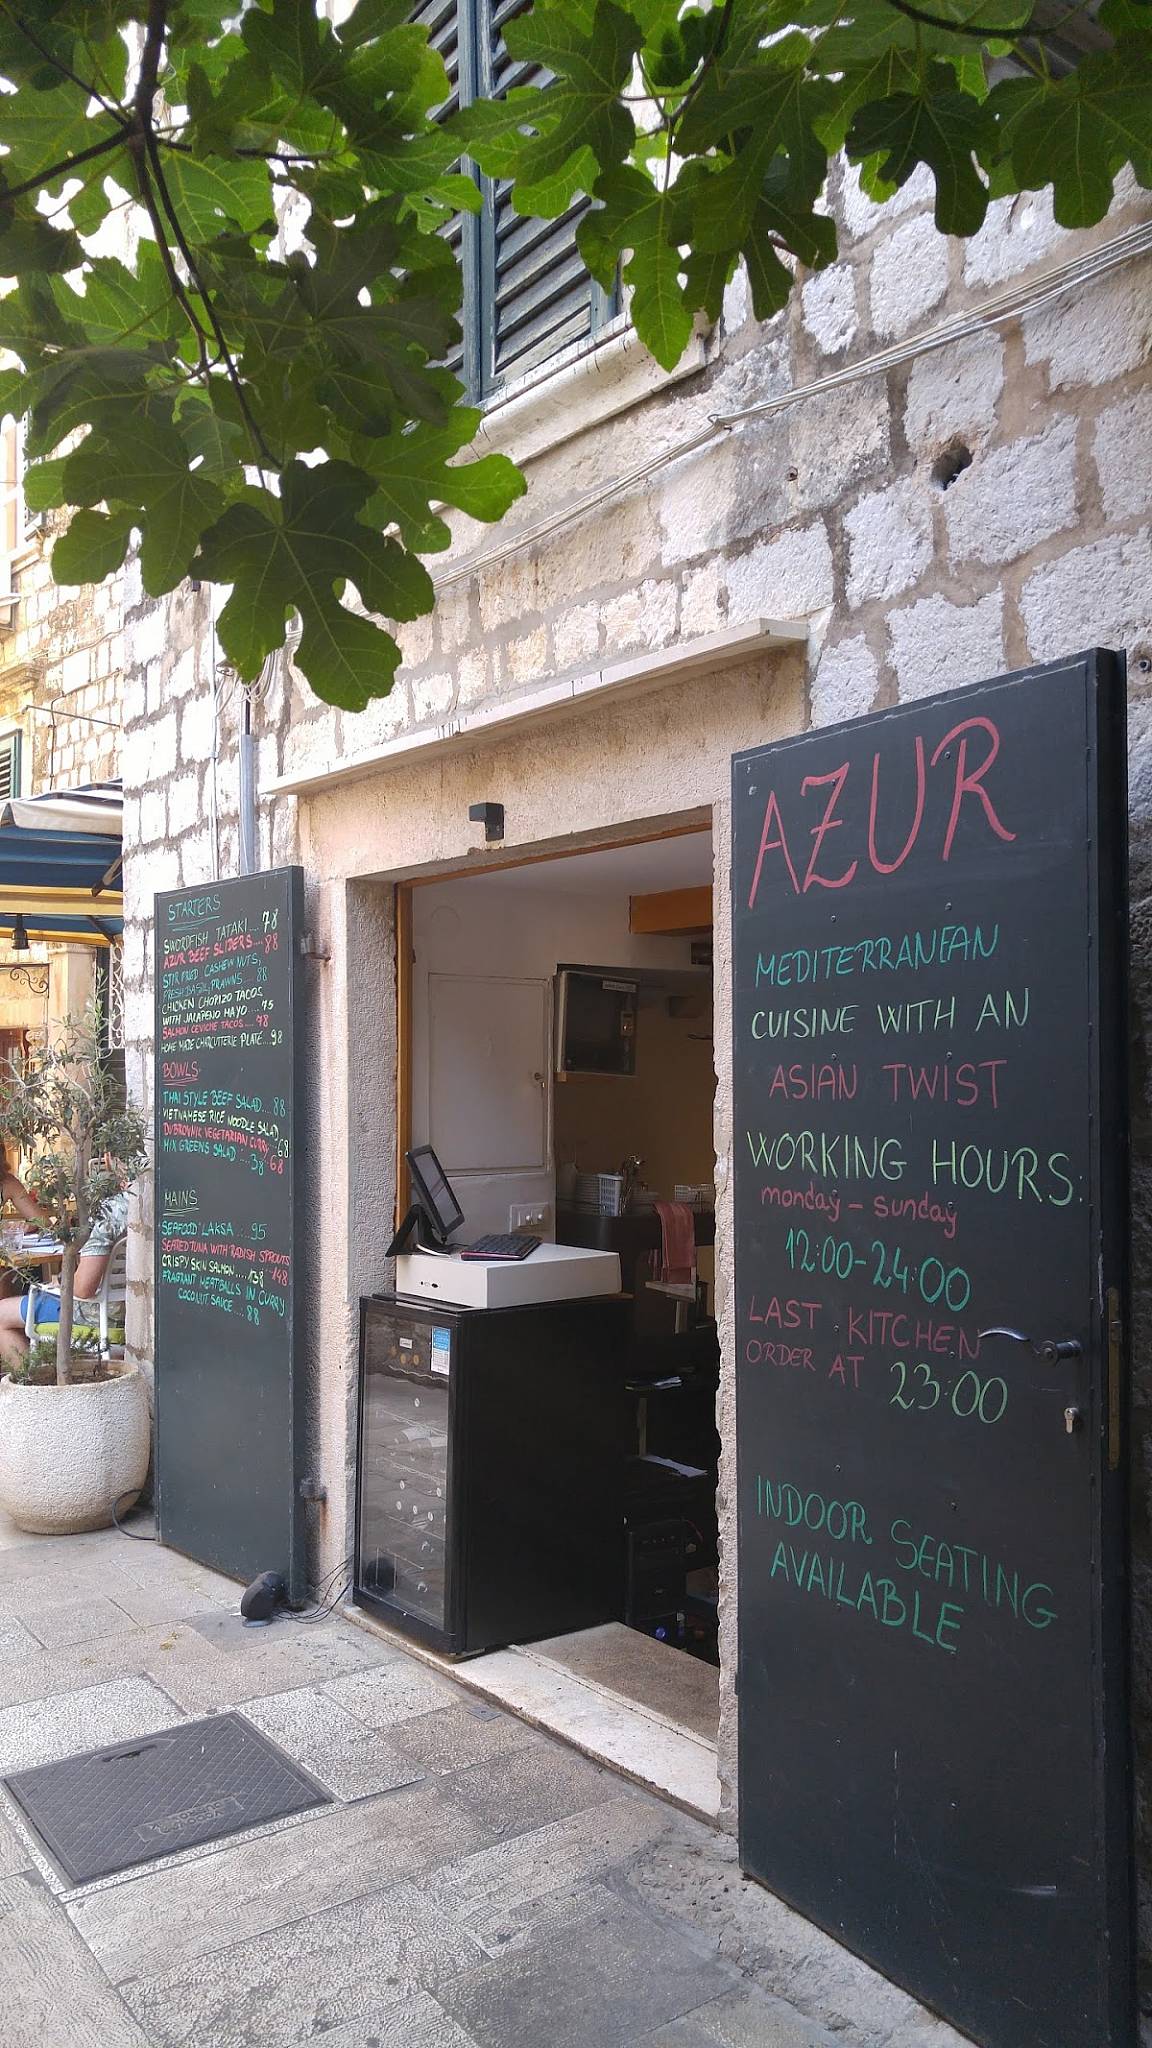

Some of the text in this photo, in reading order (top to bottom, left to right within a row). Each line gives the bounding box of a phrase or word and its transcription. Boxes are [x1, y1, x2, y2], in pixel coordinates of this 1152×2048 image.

[748, 716, 1016, 909] AZUR
[168, 894, 220, 921] STARTERS
[164, 908, 278, 954] SWORDFISH TATAKI 78
[164, 932, 278, 969] AZUR BEEF SLIDERS 88
[755, 924, 998, 988] MEDITERRANEAN
[163, 972, 180, 988] STIR
[181, 968, 198, 981] FRIED
[204, 958, 234, 977] CASHEW
[211, 973, 243, 990] PRAWNS
[257, 966, 268, 982] 88
[162, 986, 263, 1014] CHICKEN CHORIZO TACOS
[162, 1015, 181, 1026] WITH
[224, 1005, 248, 1018] MAYO
[751, 987, 1029, 1040] CUISINE WITH AN
[160, 1040, 177, 1054] HOME
[178, 1038, 195, 1052] MADE
[270, 1029, 283, 1046] 98
[162, 1026, 189, 1040] SALMON
[191, 1021, 218, 1033] CEVICHE
[221, 1019, 244, 1029] TACOS
[162, 1061, 199, 1078] BOWLS
[769, 1059, 1008, 1108] ASIAN TWIST
[163, 1090, 285, 1117] THAI STYLE BEEF SALAD 88
[162, 1108, 289, 1158] VIETNAMESE RICE NOODLE SALAD 68
[205, 1127, 248, 1147] VEGETARIAN
[249, 1136, 269, 1161] CURRY
[270, 1155, 283, 1174] 68
[163, 1139, 264, 1175] MIX GREENS SALAD 38
[747, 1131, 907, 1181] WORKING
[164, 1189, 198, 1207] MAINS
[761, 1181, 840, 1223] monday
[874, 1192, 958, 1239] sunday
[161, 1220, 267, 1240] SEAFOOD LAKSA 95
[162, 1238, 189, 1252] SEARED
[190, 1240, 208, 1254] TUNA
[210, 1243, 228, 1257] WITH
[228, 1245, 256, 1262] RADISH
[259, 1249, 290, 1266] SPROUTS
[162, 1254, 189, 1268] CRISPY
[209, 1260, 235, 1276] SALMON
[162, 1269, 285, 1316] FRAGRANT MEATBALLS IN CURRY
[178, 1287, 260, 1326] COCONUT SAUCE 88
[748, 1296, 982, 1359] LAST KITCHEN
[745, 1340, 816, 1372] ORDER
[828, 1355, 865, 1388] AT
[757, 1475, 1058, 1629] INDOOR SEATING
[770, 1541, 964, 1651] AVAILABLE
